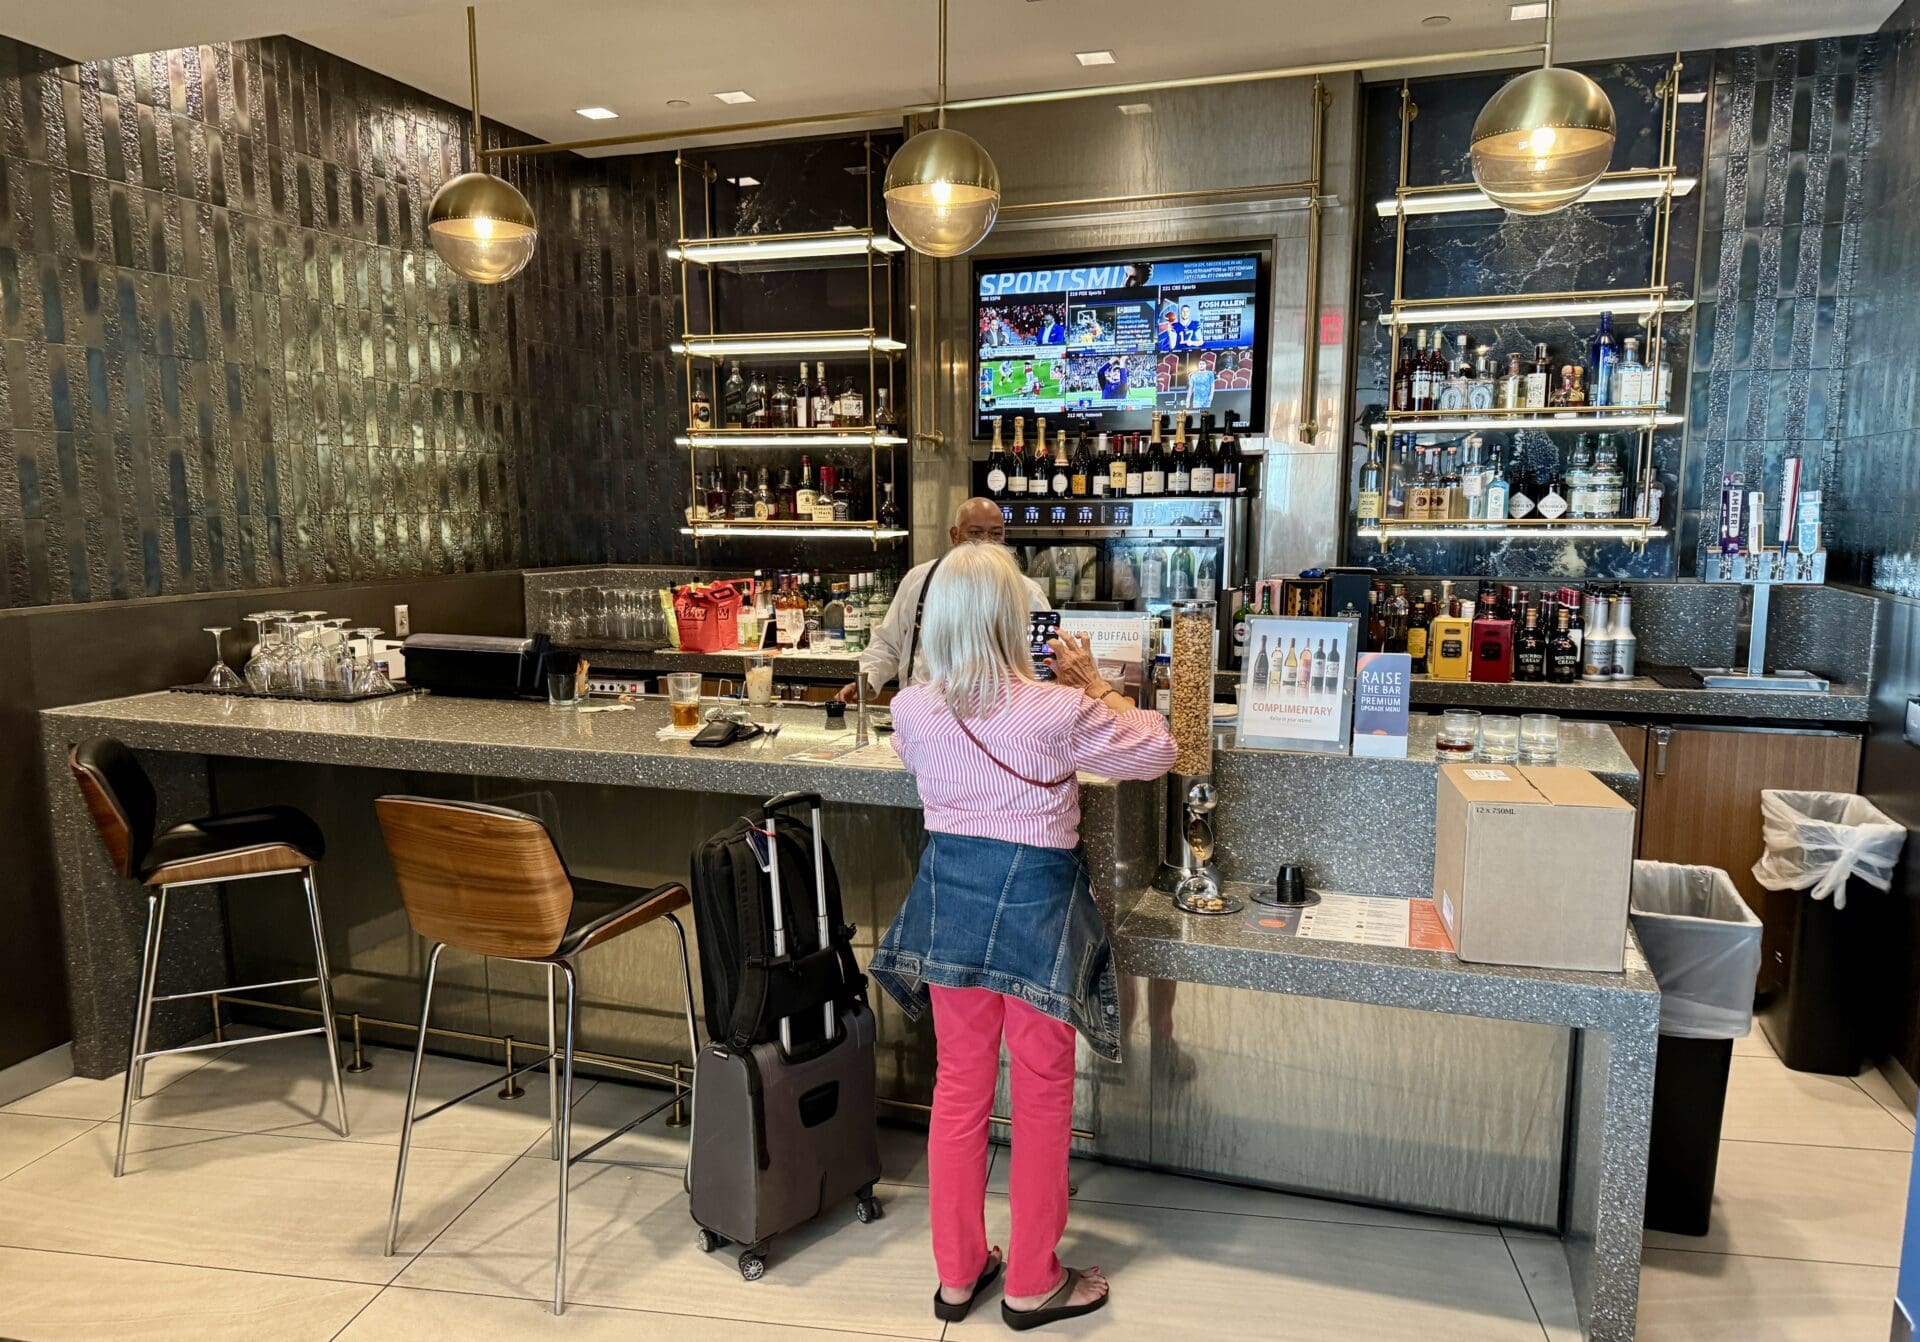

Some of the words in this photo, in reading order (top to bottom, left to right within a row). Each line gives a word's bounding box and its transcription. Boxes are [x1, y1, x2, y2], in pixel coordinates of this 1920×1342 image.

[1200, 301, 1219, 309] JOSH
[1220, 299, 1245, 307] ALLEN
[1179, 330, 1194, 343] 17
[1730, 491, 1740, 525] AMBER
[1098, 631, 1139, 641] BUFFALO
[1362, 671, 1402, 685] RAISE
[1362, 685, 1380, 694] THE
[1382, 685, 1401, 695] BAR
[1361, 696, 1401, 706] PREMIUM
[1252, 702, 1333, 716] COMPLIMENTARY
[1360, 705, 1383, 713] UPGRADE
